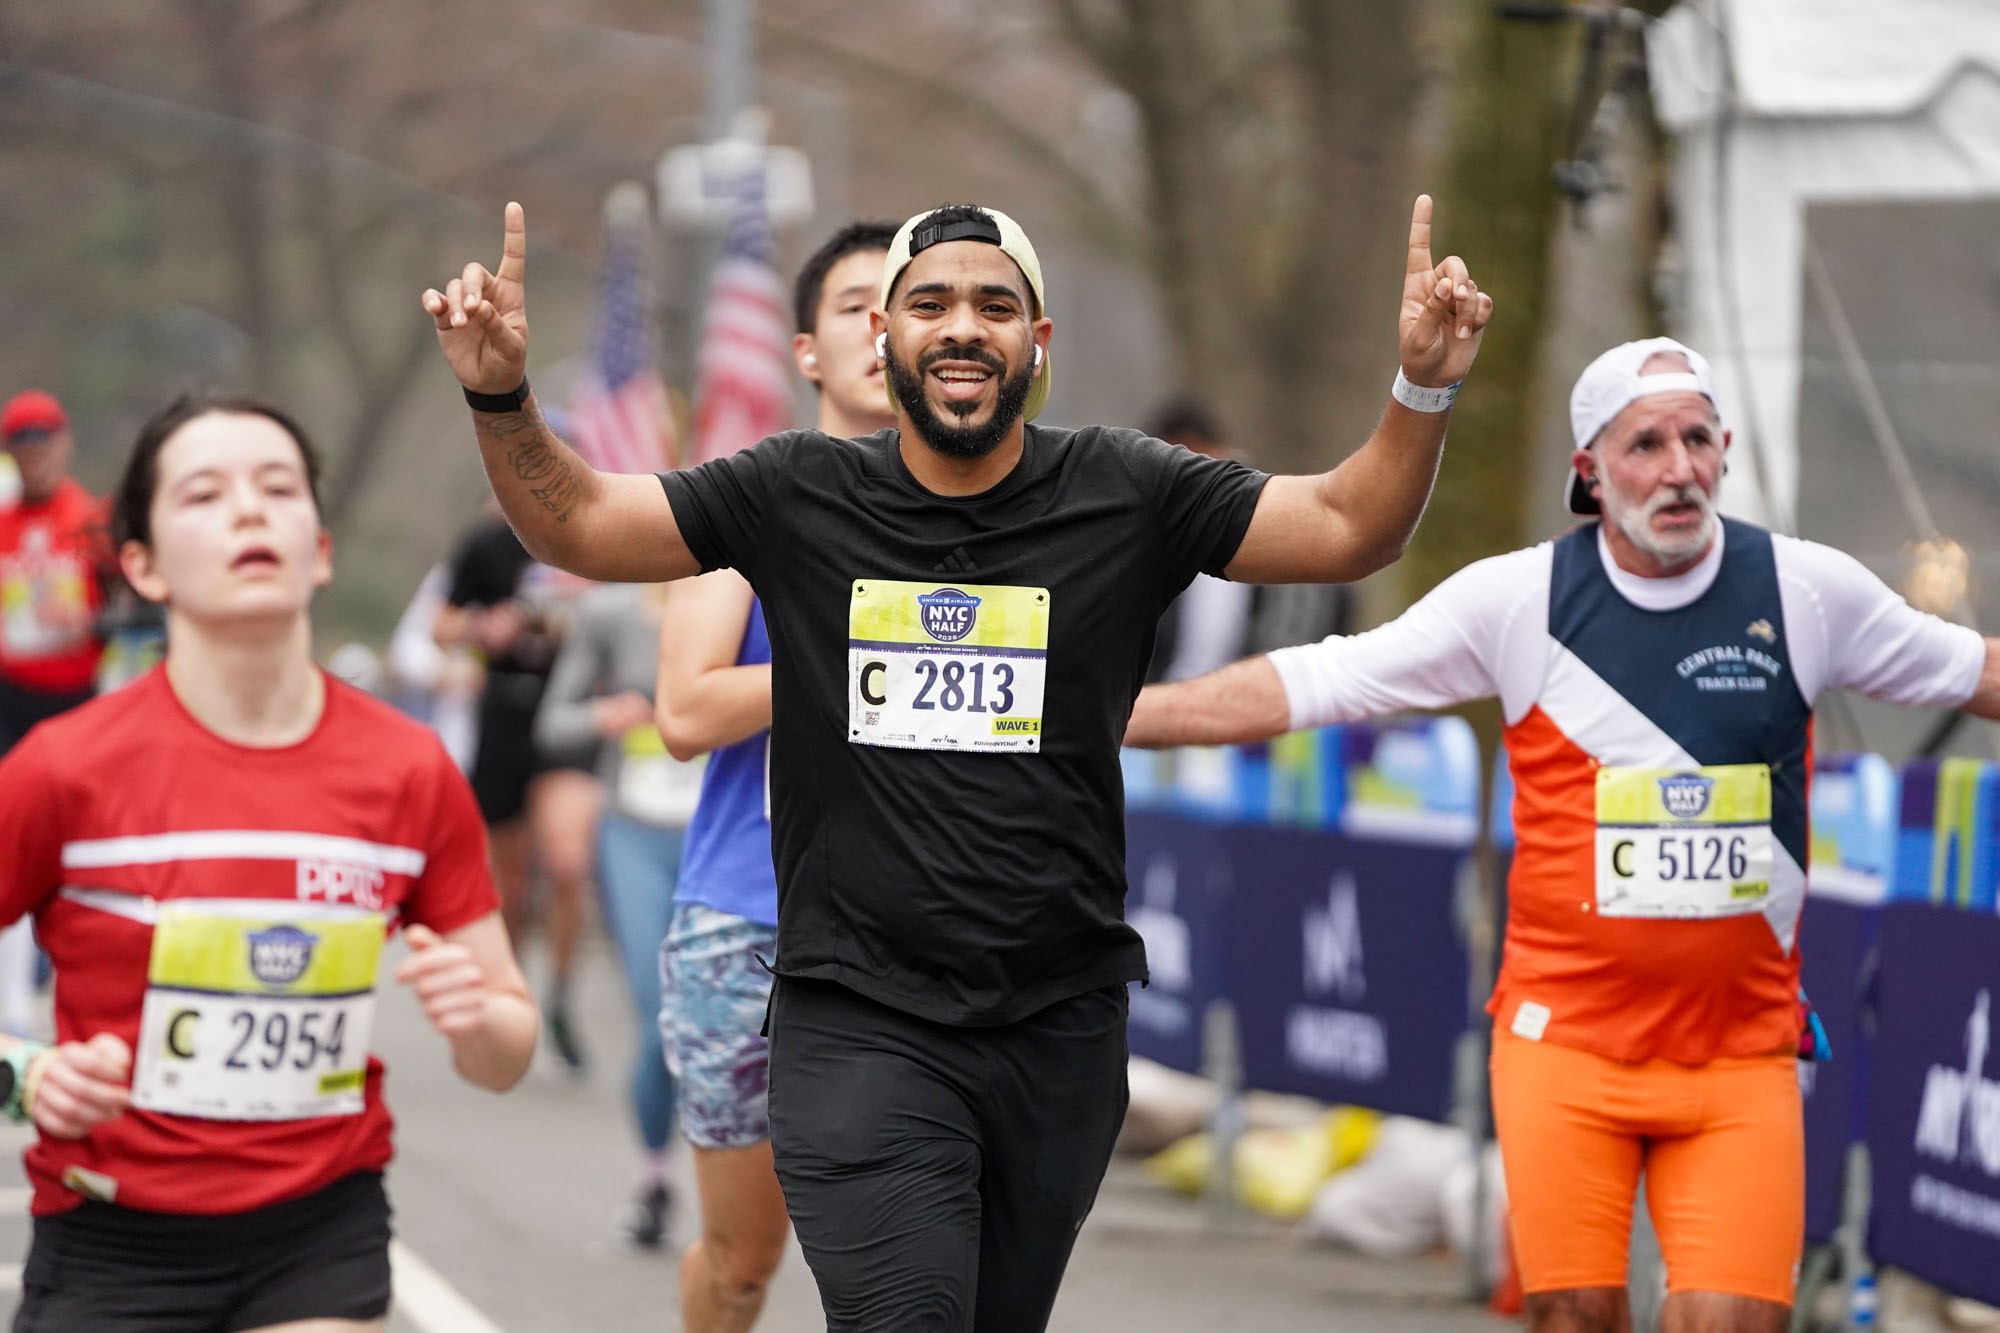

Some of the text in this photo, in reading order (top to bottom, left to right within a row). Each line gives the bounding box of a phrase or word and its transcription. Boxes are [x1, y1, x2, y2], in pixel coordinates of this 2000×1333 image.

[929, 605, 968, 622] NYC
[931, 621, 965, 632] HALF
[1676, 646, 1744, 679] CENTRAL
[860, 661, 887, 706] C
[912, 659, 1014, 714] 2813
[1695, 676, 1767, 691] TRACK CLUB
[995, 721, 1039, 731] WAVE 1
[1667, 785, 1705, 802] NYC
[1612, 835, 1748, 881] C 5126
[167, 1009, 347, 1072] C 2954
